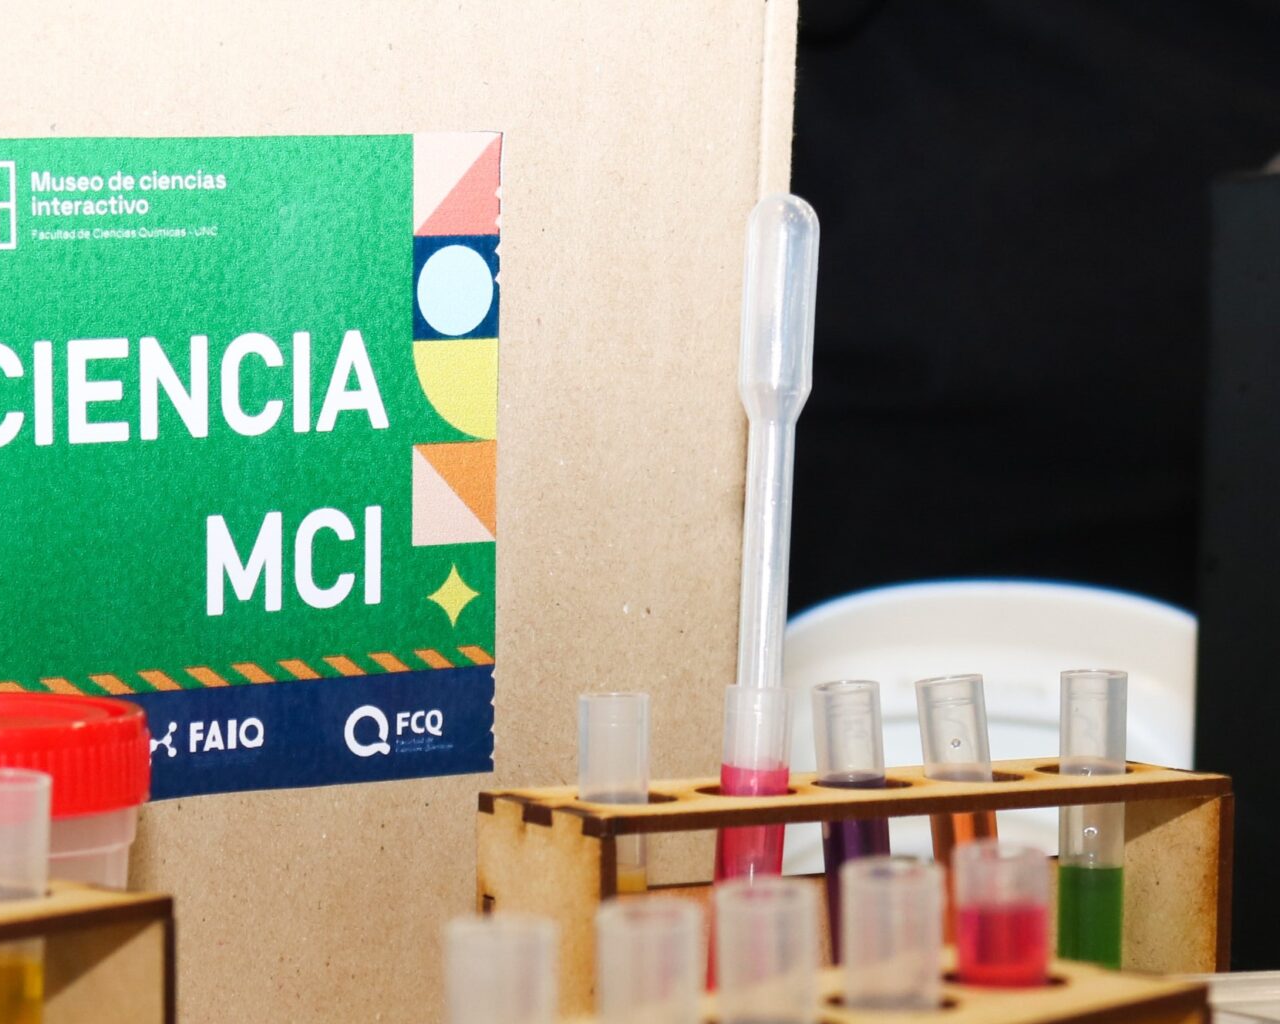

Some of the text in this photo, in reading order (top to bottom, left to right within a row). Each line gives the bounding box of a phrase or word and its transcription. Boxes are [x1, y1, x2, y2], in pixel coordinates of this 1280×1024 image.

[30, 170, 227, 192] Museo de ciencias
[31, 195, 149, 216] interactivo
[31, 229, 76, 240] Facultad
[77, 229, 91, 239] de
[92, 228, 137, 239] Ciencias
[206, 505, 382, 616] MCI
[396, 709, 444, 737] FCQ
